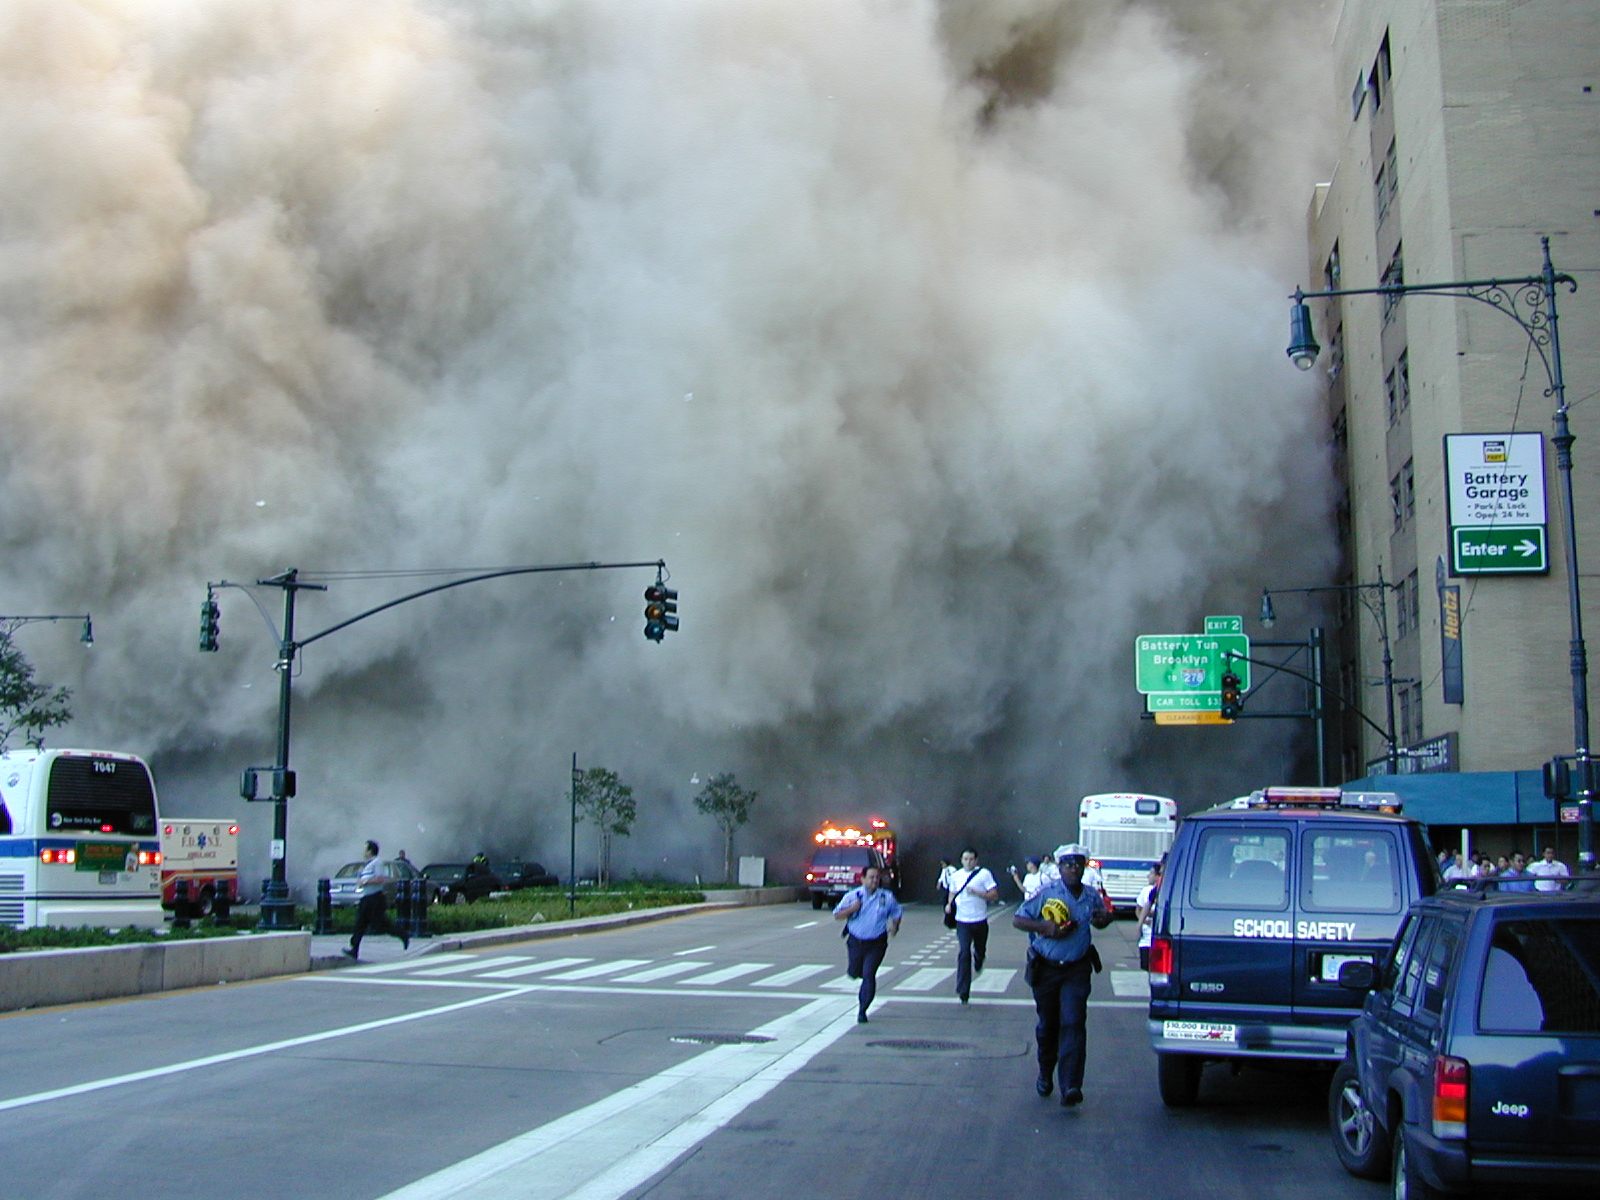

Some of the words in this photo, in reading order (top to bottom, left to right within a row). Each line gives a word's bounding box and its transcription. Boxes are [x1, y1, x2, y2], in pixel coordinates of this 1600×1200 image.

[1464, 472, 1529, 486] Battery
[1466, 486, 1529, 501] Garage
[1474, 502, 1494, 510] Park
[1507, 502, 1526, 510] Lock
[1475, 511, 1498, 520] Open
[1502, 511, 1513, 519] 24
[1516, 510, 1530, 518] hrs
[1461, 541, 1508, 557] Enter
[1444, 590, 1459, 640] Hertz
[1207, 621, 1228, 630] EXIT
[1231, 620, 1240, 631] 2
[1141, 640, 1190, 652] Battery
[1196, 640, 1219, 650] Tun
[1153, 654, 1209, 666] Brooklyn
[1156, 698, 1174, 706] CAR
[1180, 698, 1201, 706] TOLL
[92, 761, 117, 773] 7047
[824, 871, 856, 880] FIRE
[1233, 918, 1294, 938] SCHOOL
[1297, 922, 1356, 941] SAFETY
[1166, 1021, 1198, 1031] $10,000
[1200, 1023, 1233, 1032] REWARD
[1491, 1101, 1530, 1117] Jeep
